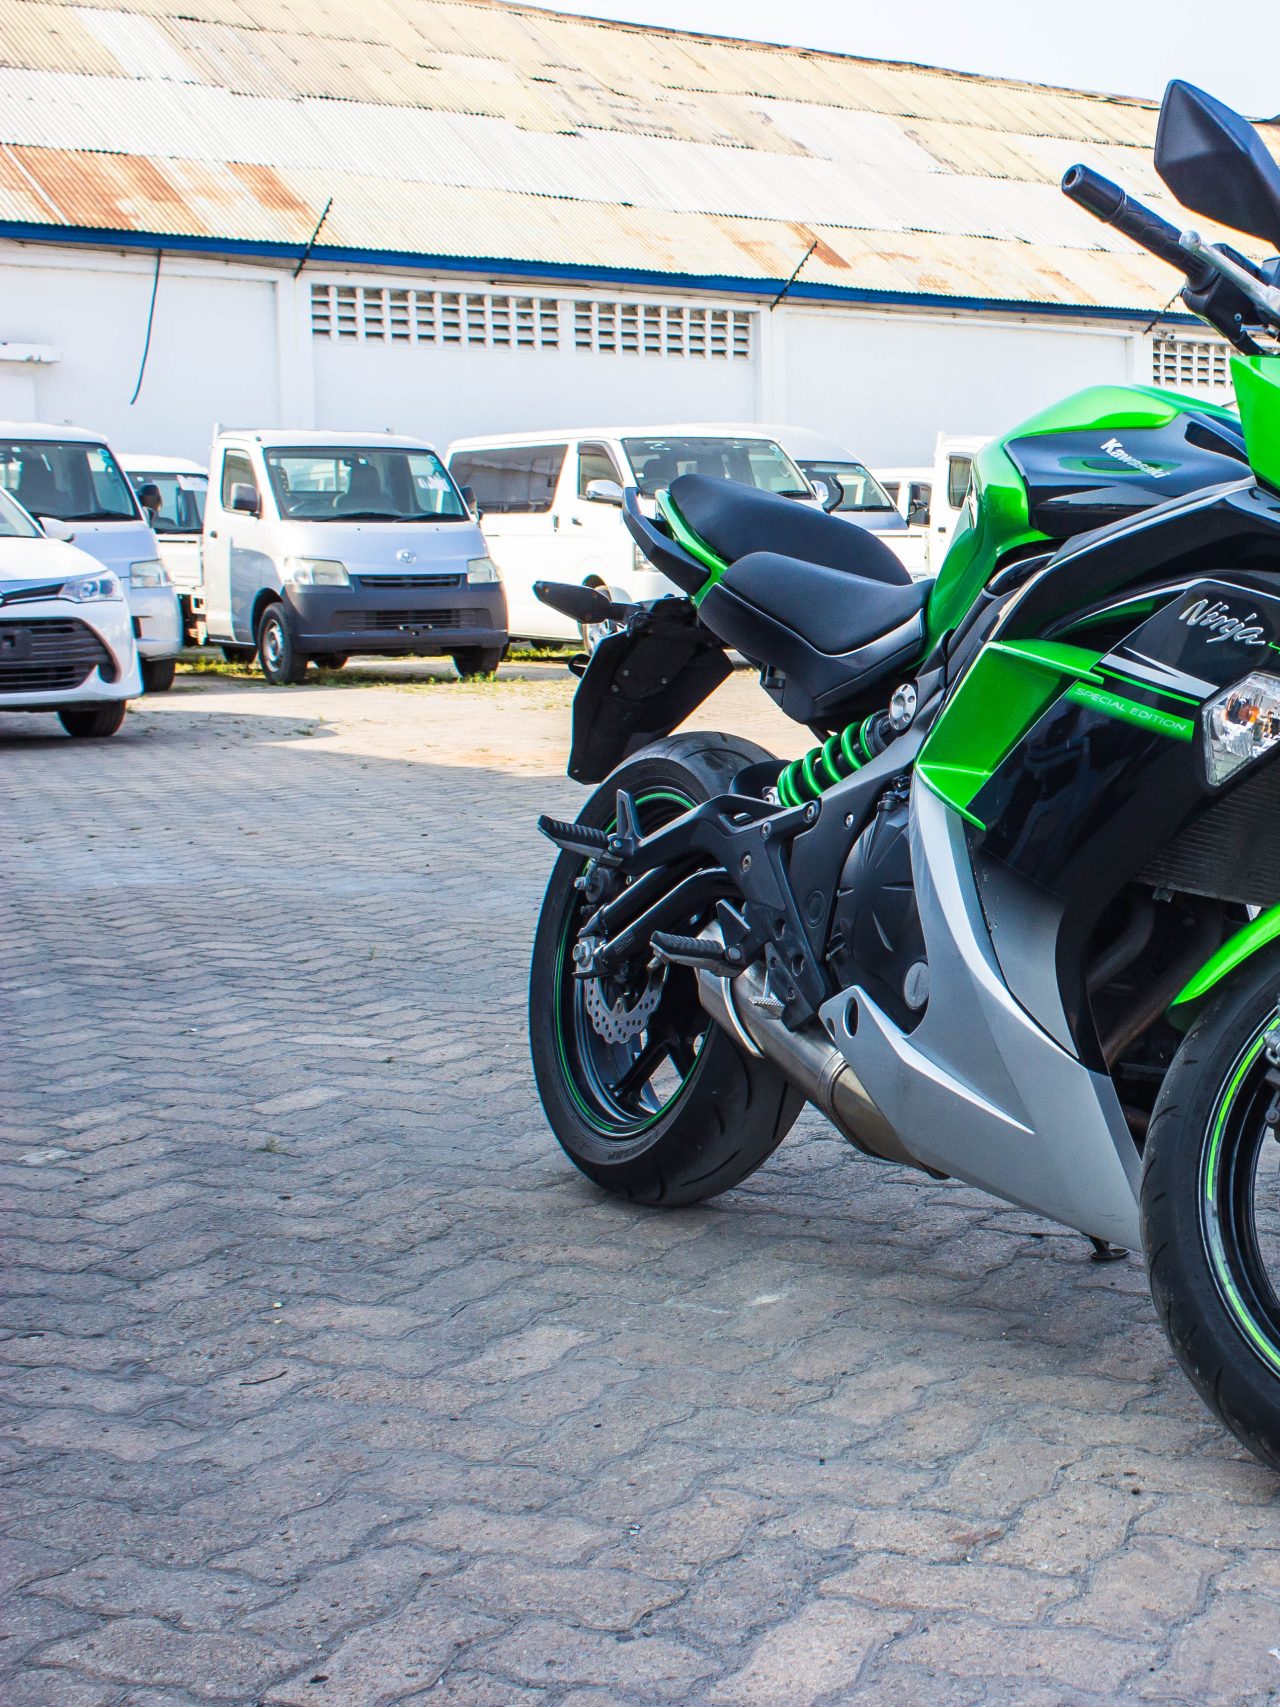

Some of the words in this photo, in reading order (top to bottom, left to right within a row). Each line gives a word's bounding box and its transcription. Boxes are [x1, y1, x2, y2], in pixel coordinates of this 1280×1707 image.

[1100, 438, 1171, 479] Kawasaki
[1179, 599, 1266, 645] Ninja
[1075, 688, 1126, 712] SPECIAL
[1129, 707, 1187, 731] EDITION
